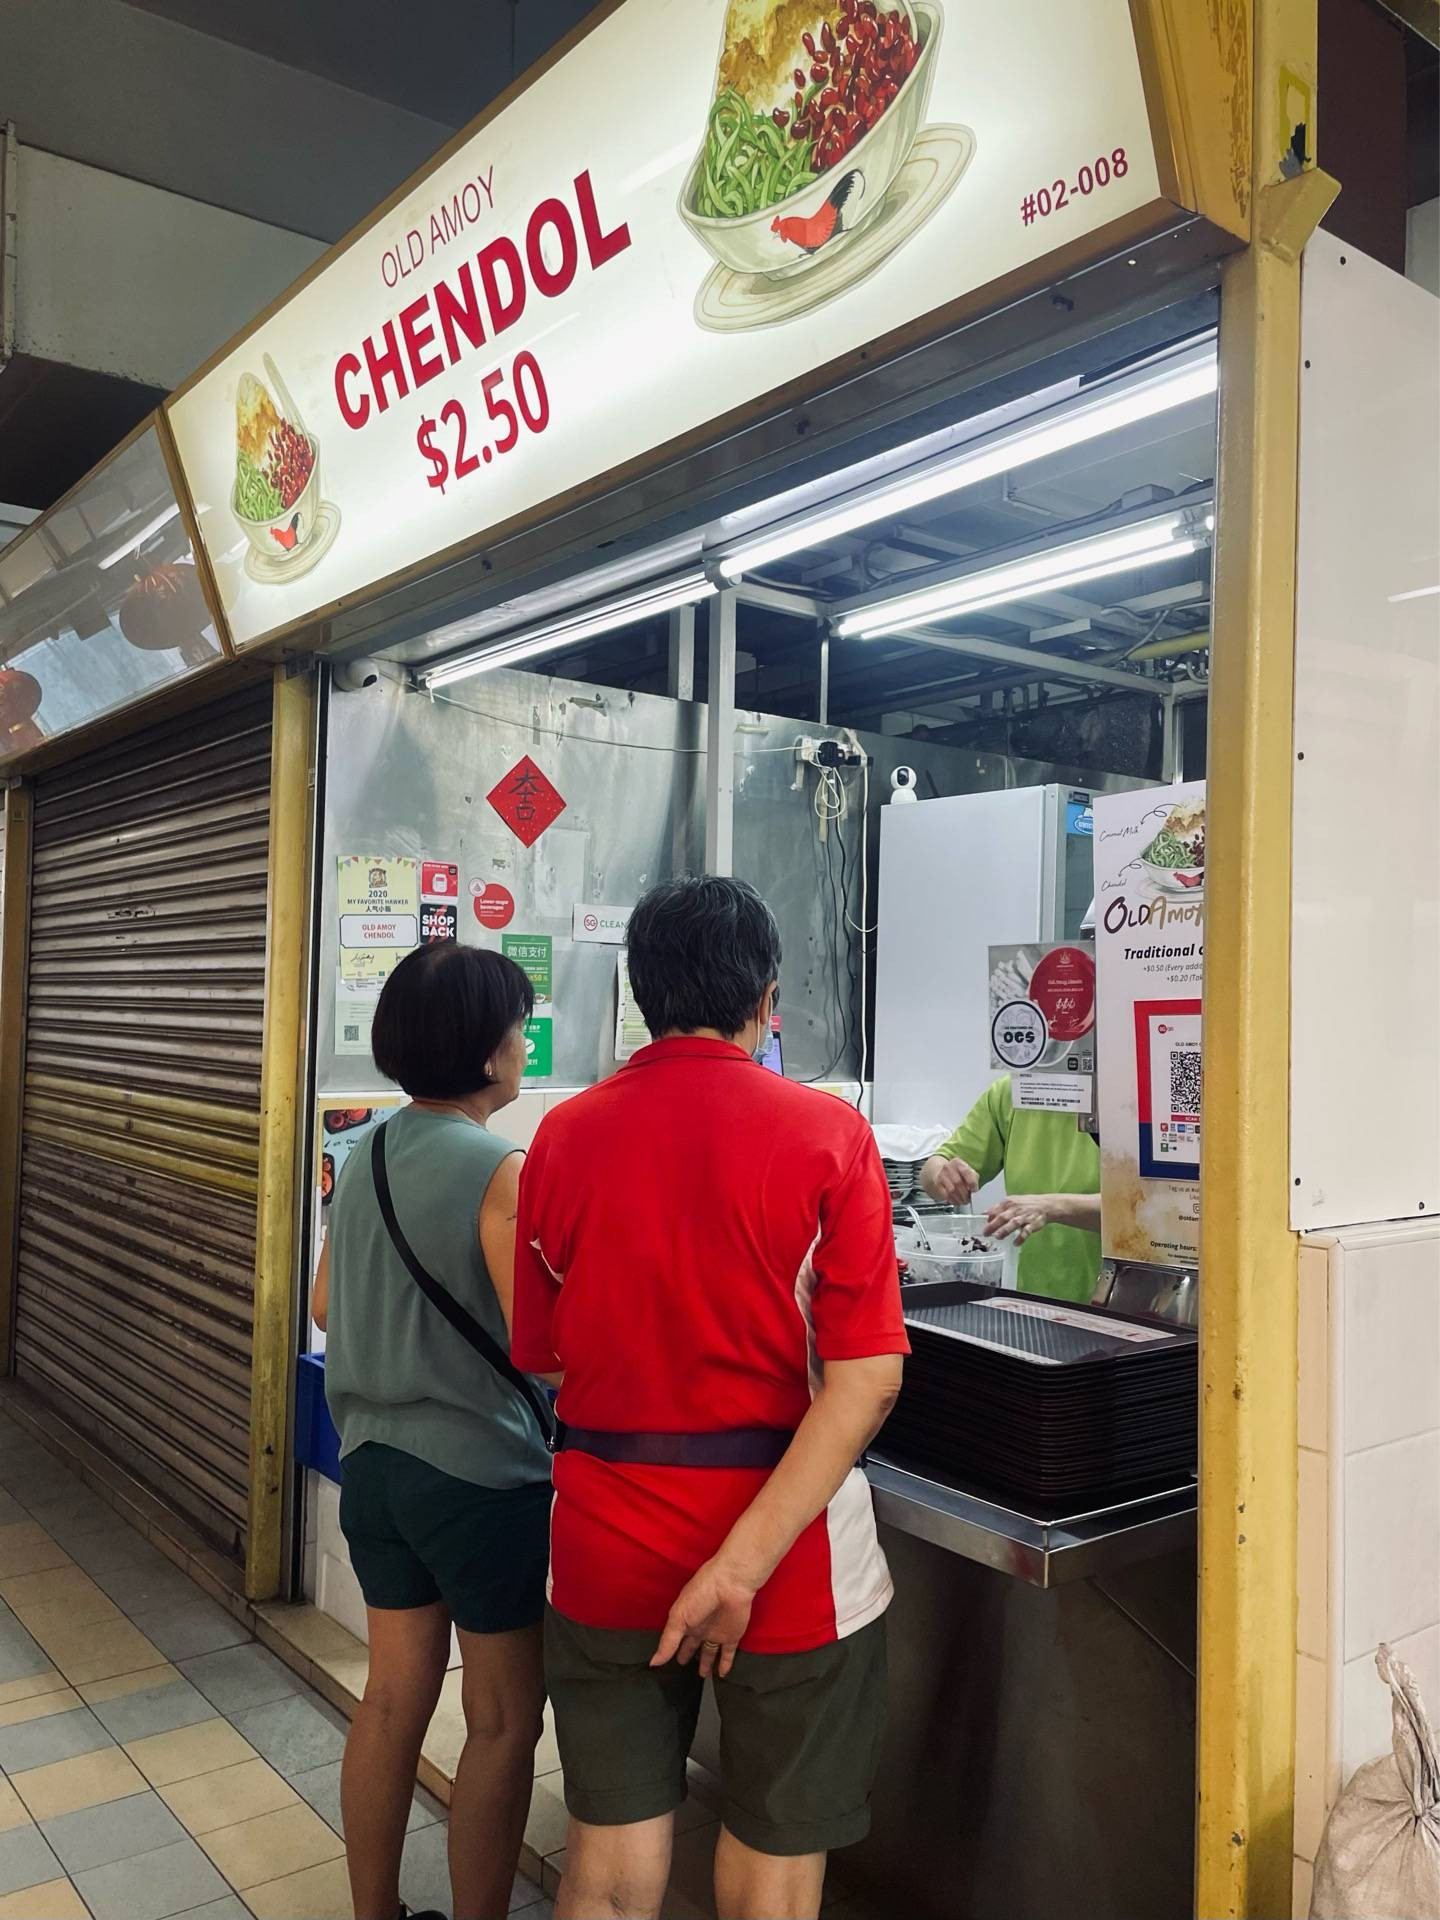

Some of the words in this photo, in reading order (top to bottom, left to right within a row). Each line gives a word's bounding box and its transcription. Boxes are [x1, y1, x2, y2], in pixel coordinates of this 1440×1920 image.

[1020, 147, 1128, 227] #02-008
[381, 229, 425, 288] OLD
[430, 165, 497, 255] AMOY
[334, 168, 632, 430] CHENDOL
[415, 350, 550, 495] $2.50
[368, 890, 388, 898] 2020
[422, 914, 455, 926] SHOP
[363, 931, 395, 939] CHENDOL
[422, 925, 455, 937] BACK
[1124, 943, 1196, 960] Traditional
[1150, 1240, 1179, 1251] Operating
